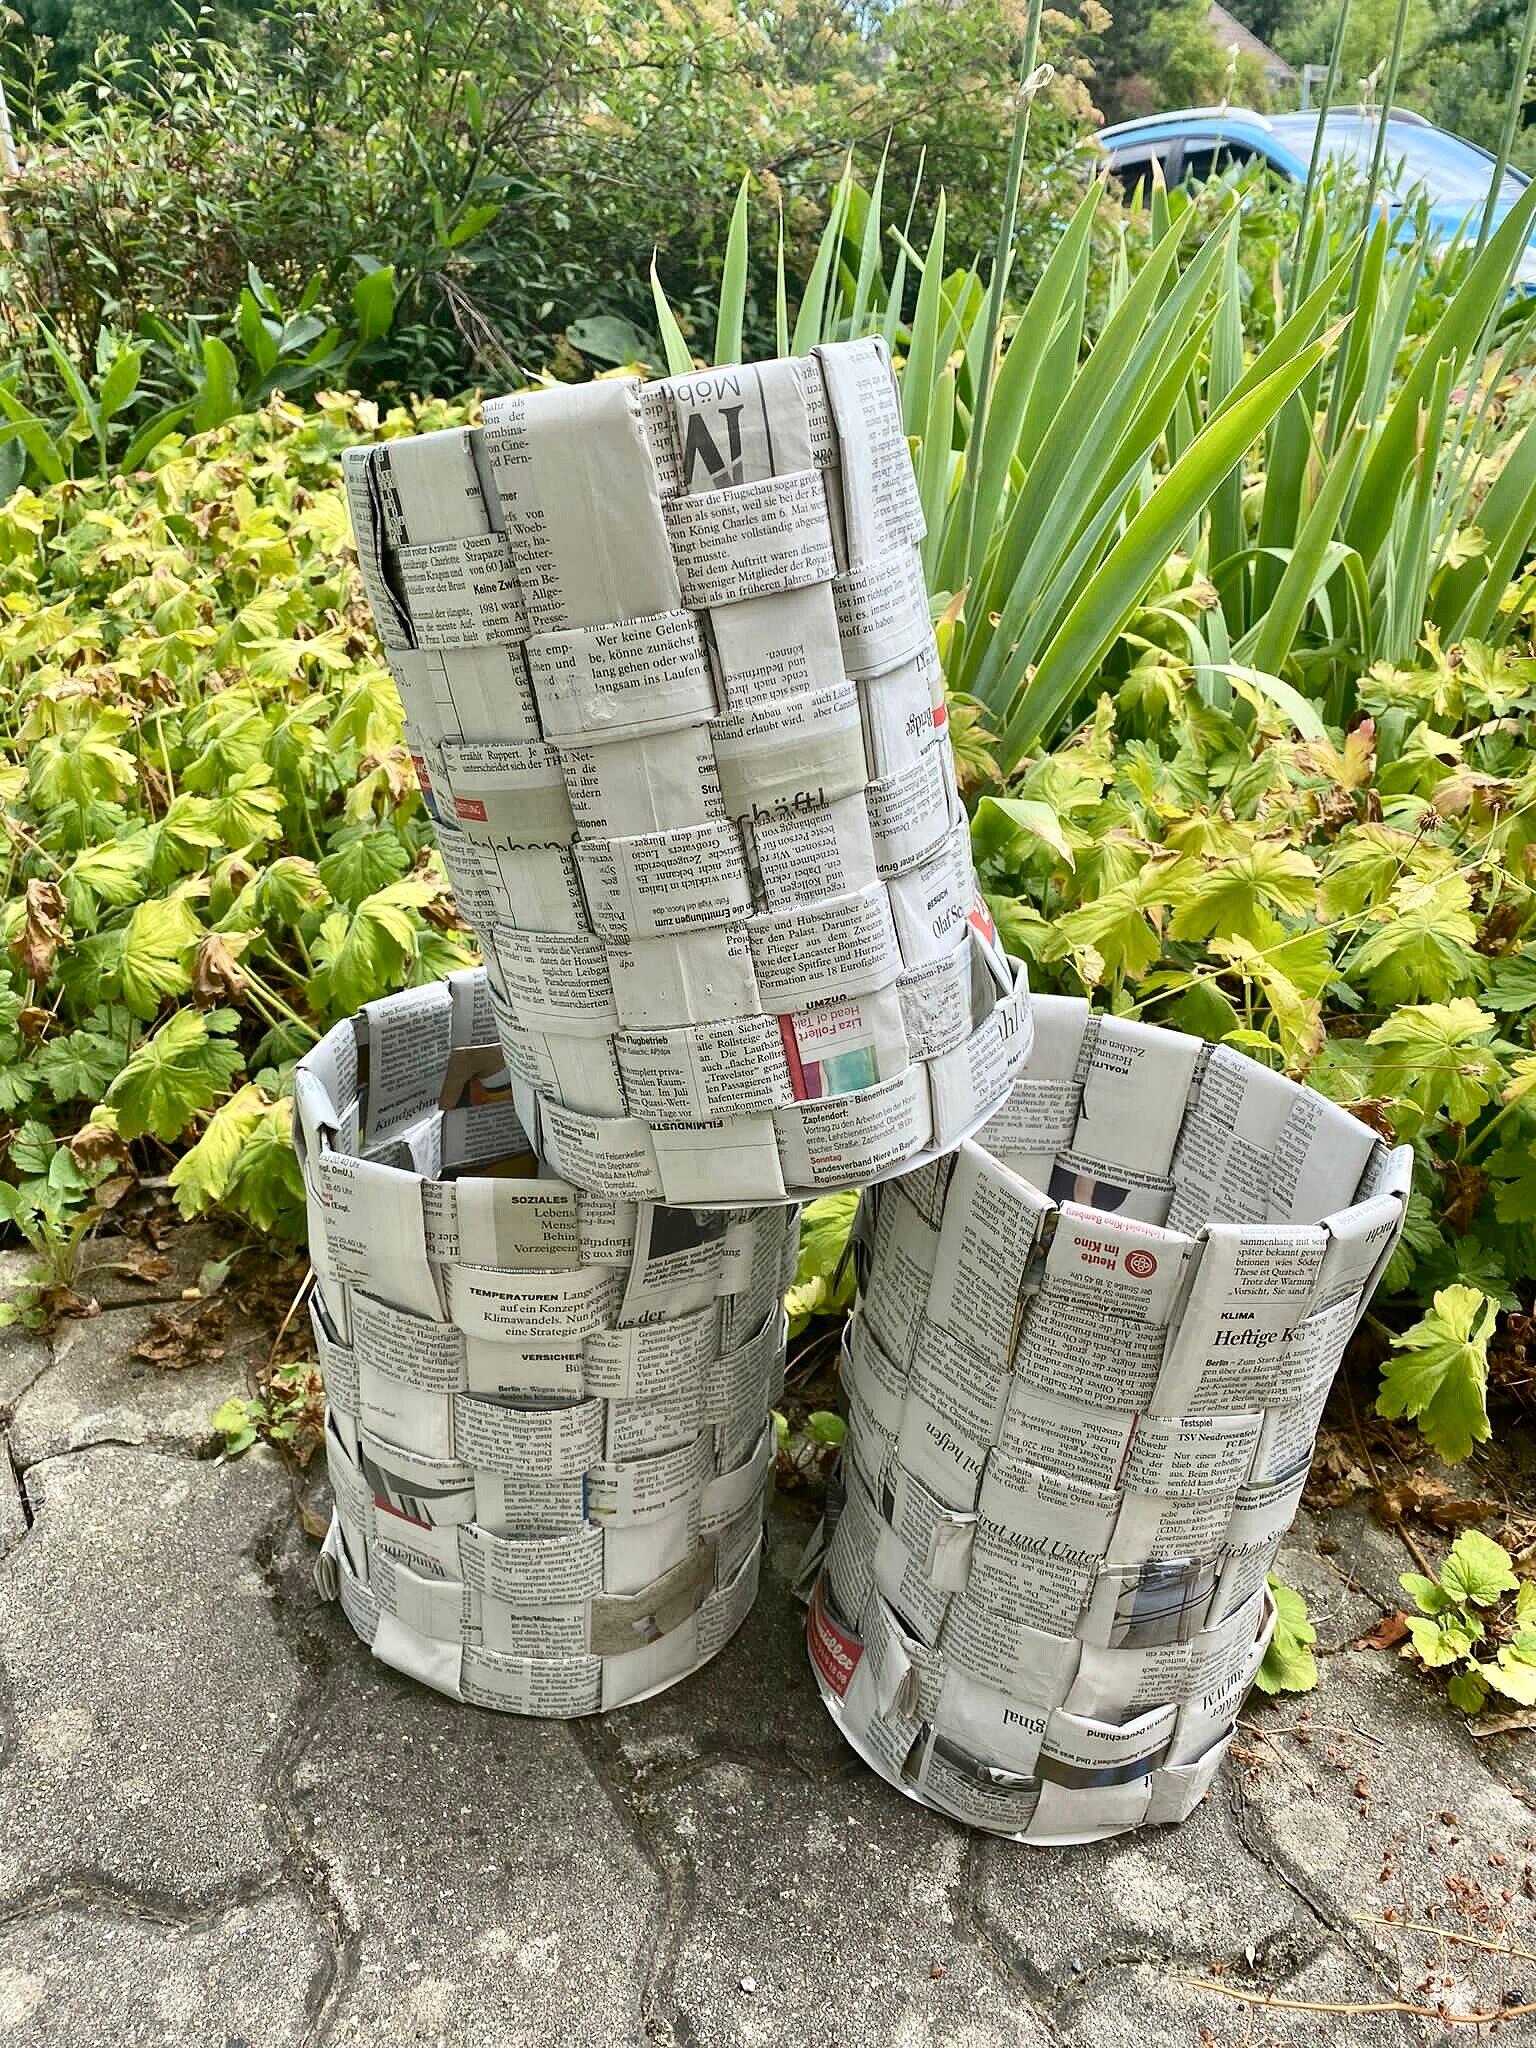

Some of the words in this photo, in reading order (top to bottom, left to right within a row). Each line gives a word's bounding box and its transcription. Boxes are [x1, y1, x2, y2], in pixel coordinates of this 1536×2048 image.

[504, 455, 532, 465] Fern-
[706, 494, 721, 505] die
[723, 482, 772, 504] Flugschau
[773, 478, 798, 491] sogar
[742, 502, 762, 513] weil
[689, 522, 720, 538] König
[722, 518, 758, 530] Charles
[700, 534, 737, 549] beinahe
[741, 522, 792, 540] vollständig
[463, 538, 491, 550] Queen
[687, 567, 703, 579] Bei
[706, 563, 727, 574] dem
[730, 555, 767, 571] Auftritt
[770, 548, 799, 561] waren
[693, 551, 730, 564] musste.
[486, 563, 497, 572] 60
[697, 577, 736, 591] weniger
[738, 567, 789, 584] Mitglieder
[739, 579, 781, 599] früheren
[783, 573, 813, 588] Jahren.
[473, 584, 497, 595] Keine
[532, 589, 562, 600] Allge-
[480, 603, 498, 614] 1981
[482, 616, 508, 627] einem
[533, 614, 568, 625] Presse-
[596, 635, 618, 647] Wer
[622, 629, 651, 643] keine
[609, 648, 643, 660] könne
[647, 636, 695, 654] zunächst
[766, 643, 804, 658] können.
[592, 666, 616, 680] lang
[619, 663, 650, 677] gehen
[653, 657, 677, 669] oder
[644, 673, 660, 687] ins
[664, 665, 701, 682] Laufen
[751, 709, 781, 723] Anbau
[746, 724, 778, 737] erlaubt
[780, 813, 832, 833] unabhängig
[630, 836, 666, 849] Bürger-
[778, 830, 809, 845] Person
[791, 836, 836, 852] Personen.
[632, 849, 659, 859] Lucio
[668, 839, 720, 854] Großvaters
[634, 855, 701, 871] Zeugenbericht
[698, 862, 721, 875] nicht
[794, 863, 821, 876] Dabei
[656, 869, 694, 881] bekannt
[722, 870, 742, 882] Frau
[638, 884, 668, 895] Italien
[681, 876, 719, 890] wirklich
[780, 875, 821, 892] Kollegen
[794, 882, 846, 901] regelmäßig
[928, 889, 949, 909] BESUCH
[655, 918, 673, 927] zum
[675, 910, 730, 924] Ermittlungen
[797, 905, 859, 926] Hubschrauber
[788, 927, 816, 941] Palast.
[822, 915, 862, 932] Darunter
[933, 918, 950, 939] Olaf
[767, 944, 800, 956] Flieger
[794, 944, 836, 962] Lancaster
[838, 935, 870, 951] Bomber
[798, 956, 831, 972] Spitfire
[760, 975, 806, 989] Formation
[827, 968, 838, 976] 18
[817, 1014, 827, 1024] of
[831, 1005, 859, 1021] Head
[839, 1018, 862, 1029] Liza
[626, 1036, 668, 1046] Flugbetrieb
[698, 1042, 714, 1051] alle
[718, 1034, 761, 1048] Rollsteige
[765, 1029, 779, 1038] des
[709, 1029, 734, 1040] einen
[799, 1025, 836, 1042] Follert
[1109, 1040, 1144, 1058] Zeichen
[657, 1079, 685, 1087] Raum-
[721, 1075, 771, 1092] Passagieren
[674, 1088, 688, 1097] Juli
[708, 1088, 773, 1104] hafenterminals
[801, 1100, 849, 1114] Imkerverein
[855, 1080, 903, 1104] Bienenfreunde
[804, 1124, 830, 1135] Vortrag
[856, 1113, 883, 1126] Arbeiten
[811, 1155, 841, 1165] Sonntag
[812, 1155, 871, 1174] Landesverband
[873, 1148, 890, 1163] Niere
[814, 1166, 875, 1183] Regionalgruppe
[877, 1155, 905, 1174] Bamberg
[1066, 1208, 1102, 1224] Bamberg
[1074, 1237, 1101, 1252] Kino
[1104, 1245, 1119, 1257] im
[1081, 1254, 1116, 1271] Heute
[470, 1288, 558, 1301] TEMPERATUREN
[539, 1302, 584, 1314] Konzept
[484, 1312, 563, 1325] Klimawandels.
[566, 1313, 588, 1323] Nun
[635, 1310, 666, 1323] der
[530, 1326, 577, 1336] Strategie
[1214, 1330, 1277, 1347] Heftige
[1181, 1419, 1213, 1428] Testspiel
[926, 1424, 963, 1463] helfen
[1041, 1475, 1061, 1483] Viele
[1010, 1531, 1048, 1550] und
[1004, 1709, 1046, 1735] ginal
[1087, 1727, 1145, 1742] Deutschland
